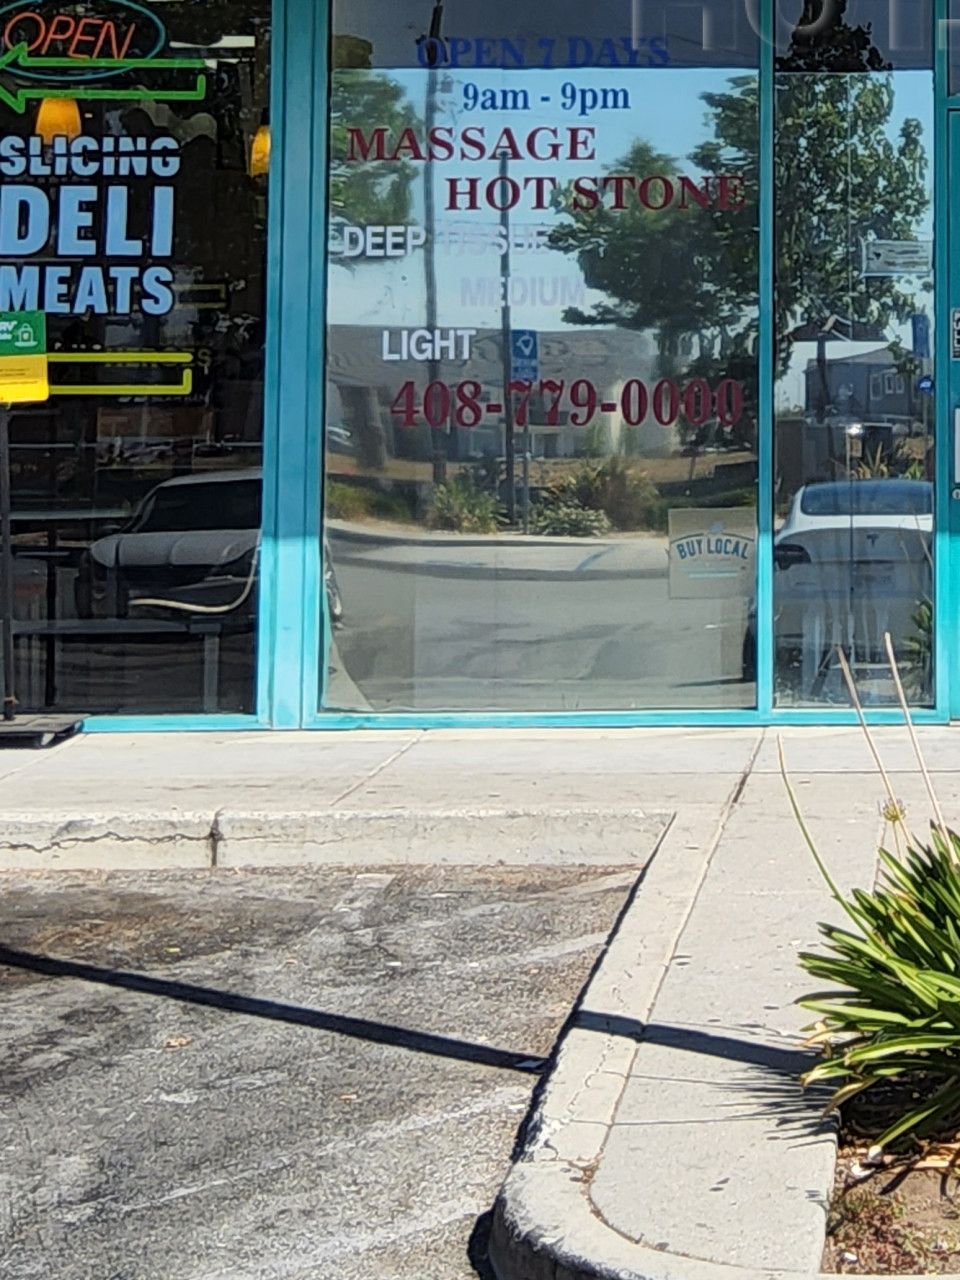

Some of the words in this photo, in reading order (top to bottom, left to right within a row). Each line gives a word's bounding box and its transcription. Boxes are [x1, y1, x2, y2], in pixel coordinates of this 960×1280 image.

[4, 12, 136, 60] OPEN
[416, 36, 526, 67] OPEN
[537, 37, 555, 66] 7
[569, 36, 671, 67] DAYS
[462, 82, 530, 111] 9am
[560, 82, 631, 116] 9pm
[0, 135, 181, 177] SLICING
[346, 126, 597, 161] MASSAGE
[444, 176, 557, 211] HOT
[572, 175, 748, 212] STONE
[0, 184, 175, 257] DELI
[342, 225, 427, 257] DEEP
[0, 264, 174, 316] MEATS
[459, 276, 586, 307] MEDIUM
[381, 329, 478, 361] LIGHT
[391, 378, 745, 429] 408-779-0000
[676, 539, 703, 560] BUY
[706, 537, 749, 560] LOCAL
